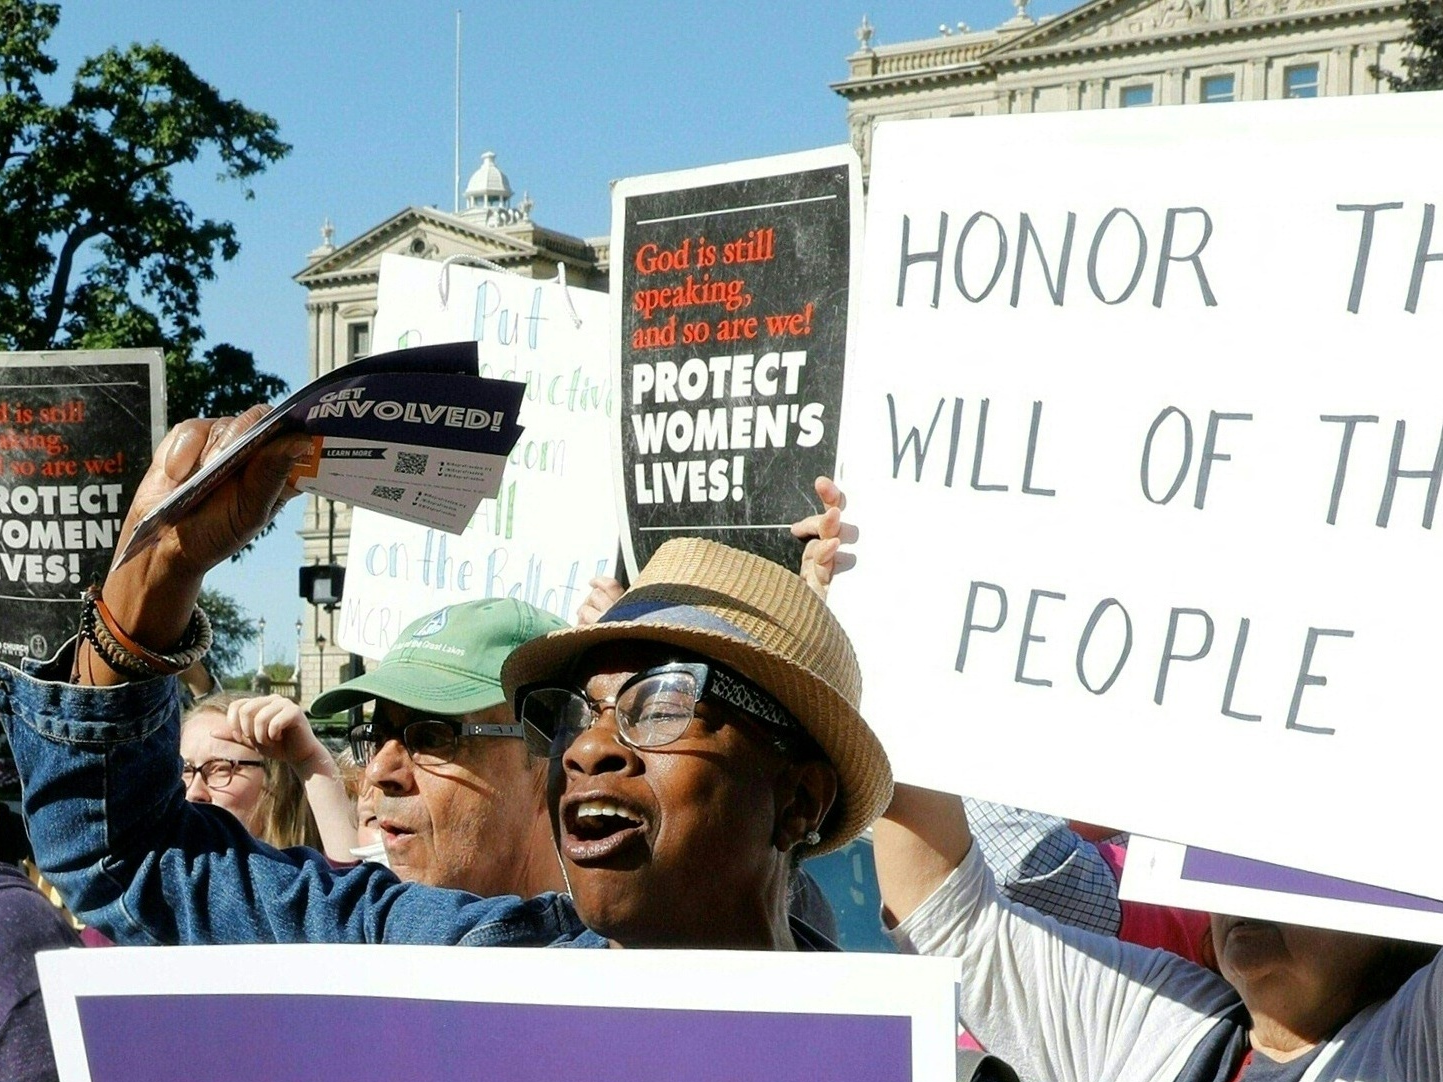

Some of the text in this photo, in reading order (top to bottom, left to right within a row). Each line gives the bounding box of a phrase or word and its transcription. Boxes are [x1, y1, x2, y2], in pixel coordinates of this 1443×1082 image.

[634, 227, 775, 275] God is still
[895, 206, 1218, 309] HONOR
[473, 279, 549, 350] Put
[633, 275, 753, 320] speaking,
[631, 302, 815, 350] and so are we!
[318, 386, 367, 403] GET
[632, 350, 807, 405] PROTECT
[14, 402, 34, 424] is
[39, 397, 86, 423] still
[306, 400, 505, 433] INVOLVED!
[631, 402, 825, 455] WOMEN'S
[10, 460, 36, 477] so
[41, 459, 78, 477] are
[83, 450, 125, 475] we!
[886, 392, 1056, 497] WILL
[1140, 404, 1254, 510] OF
[634, 455, 745, 505] LIVES!
[365, 541, 409, 581] on
[417, 529, 473, 591] the
[442, 643, 466, 657] Lakes
[953, 579, 1355, 736] PEOPLE
